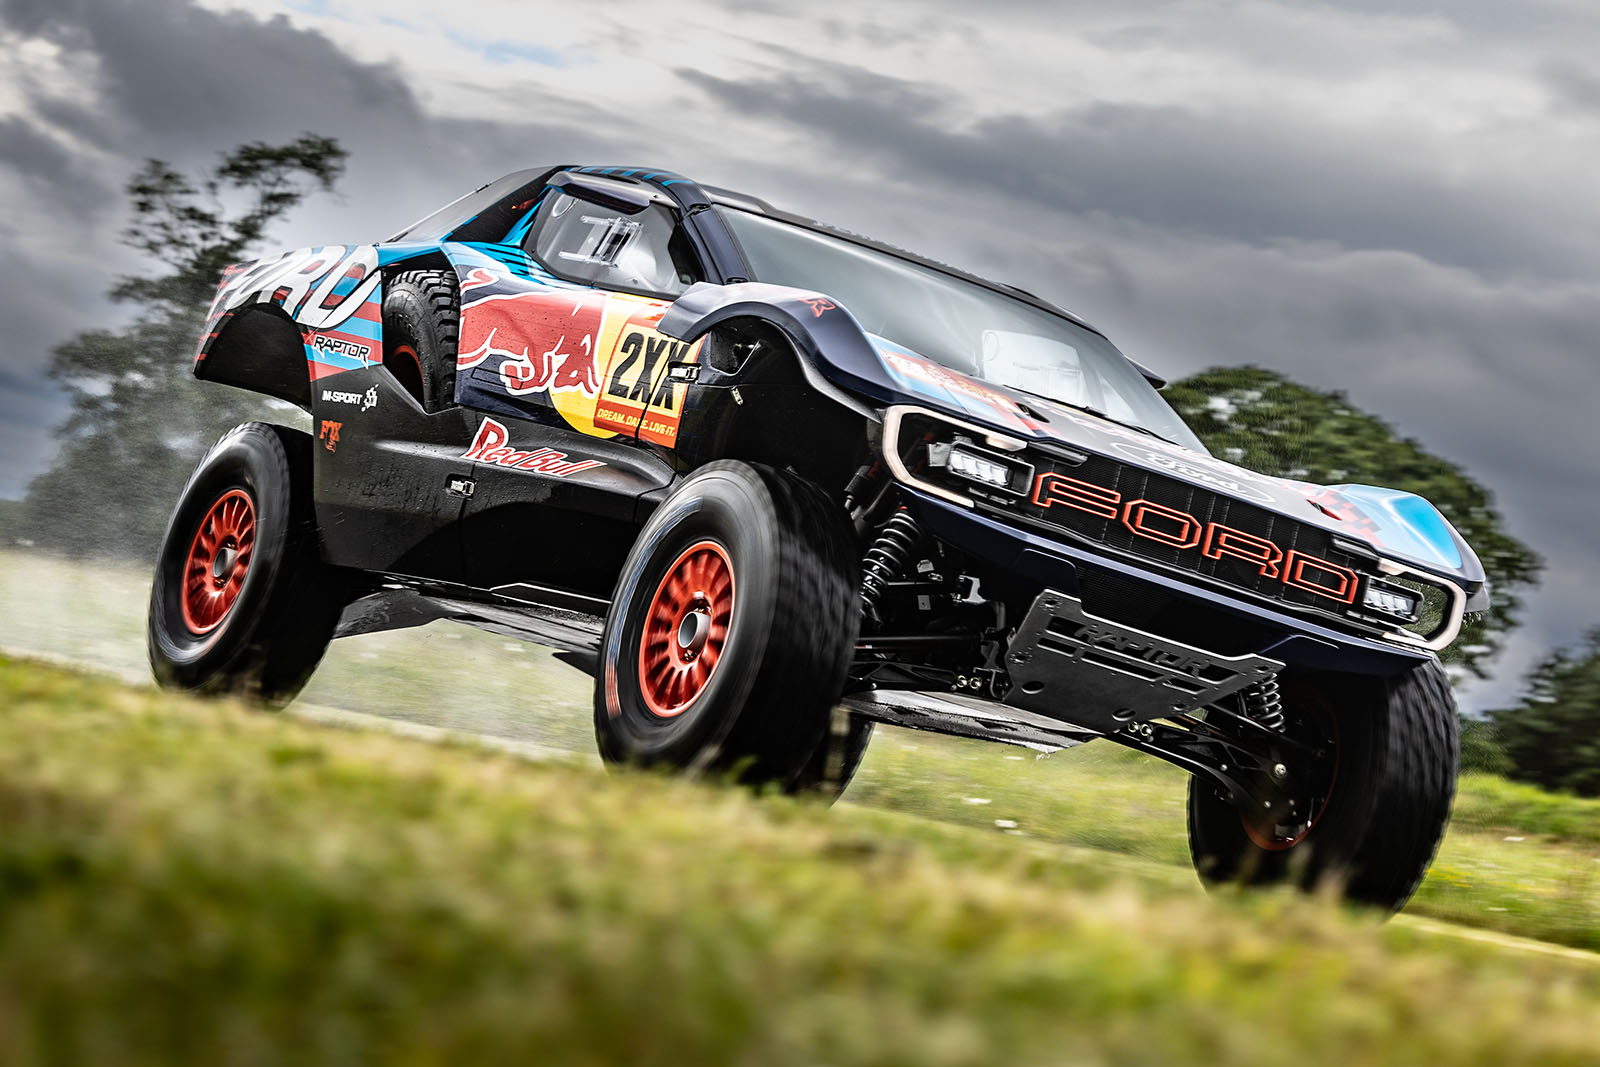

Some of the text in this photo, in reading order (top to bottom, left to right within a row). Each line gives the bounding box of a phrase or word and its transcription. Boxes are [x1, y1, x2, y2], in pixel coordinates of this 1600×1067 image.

[313, 335, 370, 367] RAPTOR
[608, 332, 691, 410] 2XX
[322, 390, 363, 405] M-SPORT
[597, 408, 625, 424] DREAM.
[319, 420, 342, 452] FOX
[1032, 472, 1359, 604] FORD
